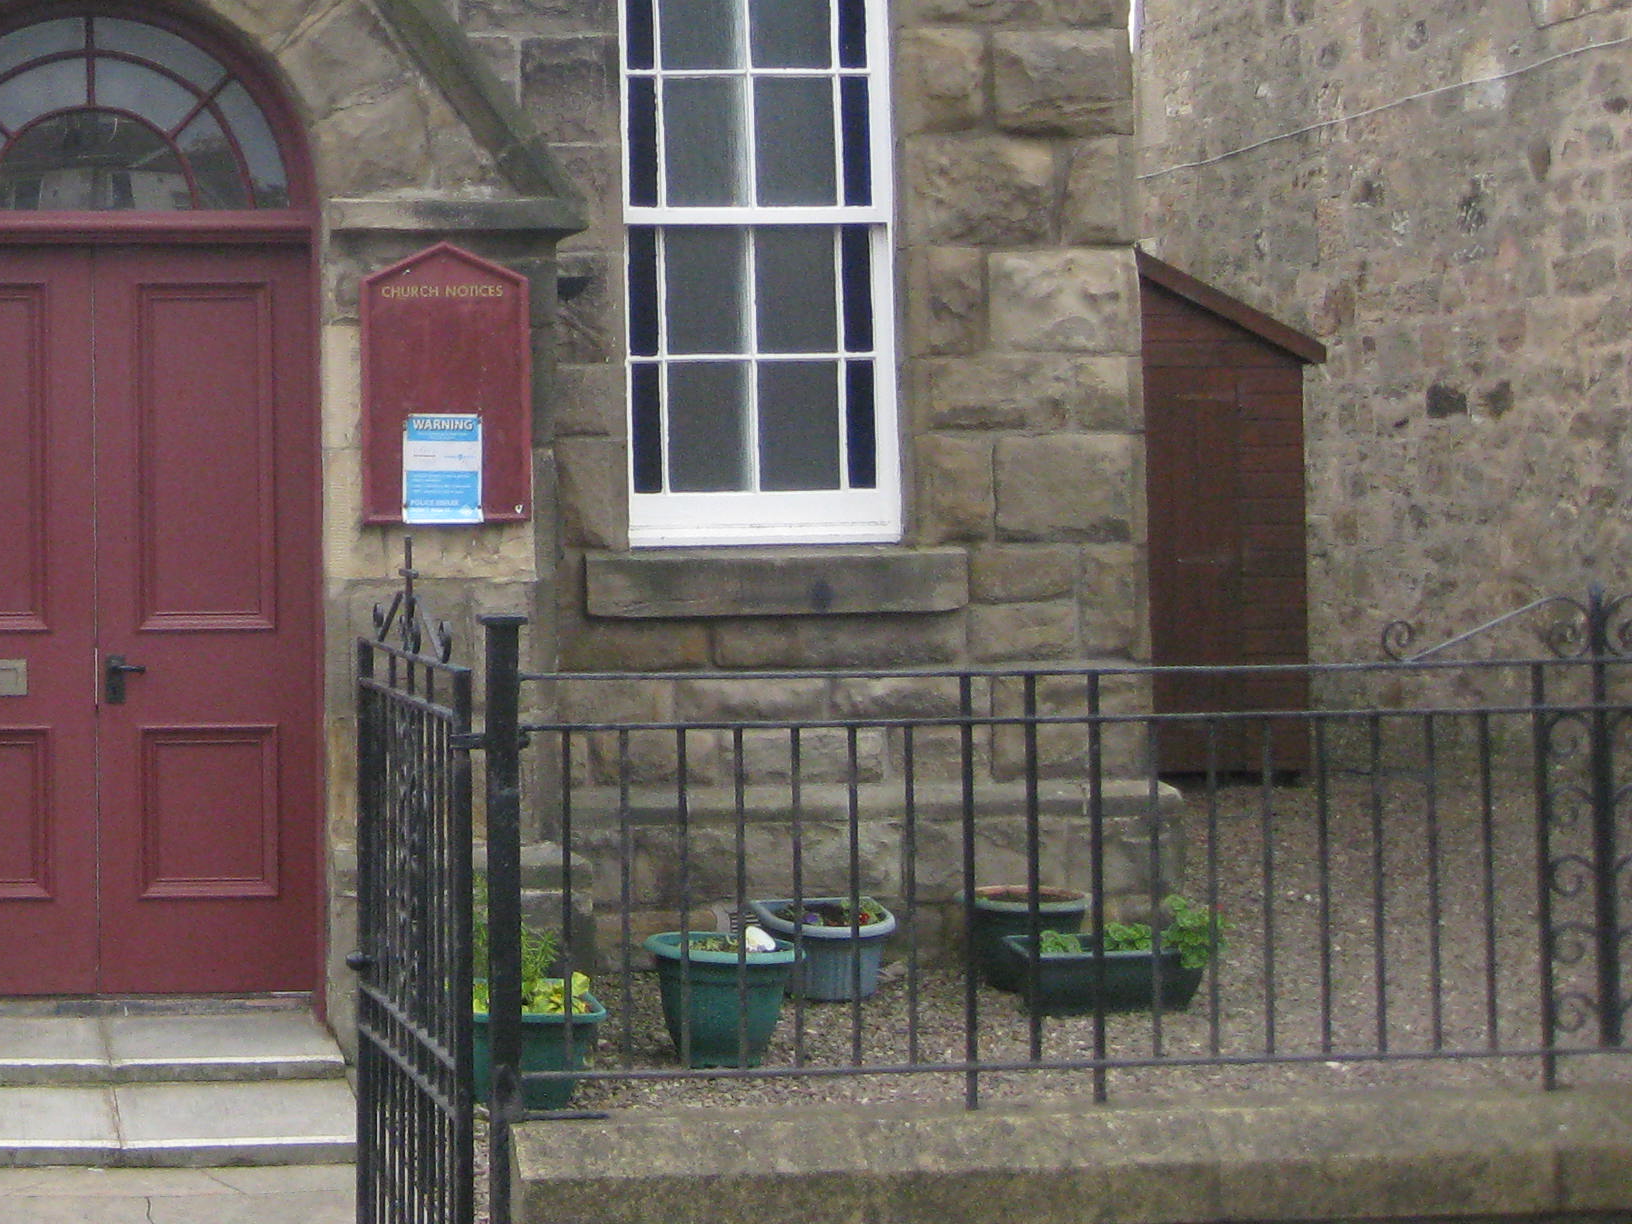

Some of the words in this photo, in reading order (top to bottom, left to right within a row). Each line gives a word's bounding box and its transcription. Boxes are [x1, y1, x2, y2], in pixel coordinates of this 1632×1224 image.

[382, 286, 439, 297] CHURCH
[445, 285, 503, 297] NOTICES
[412, 419, 473, 431] WARNING
